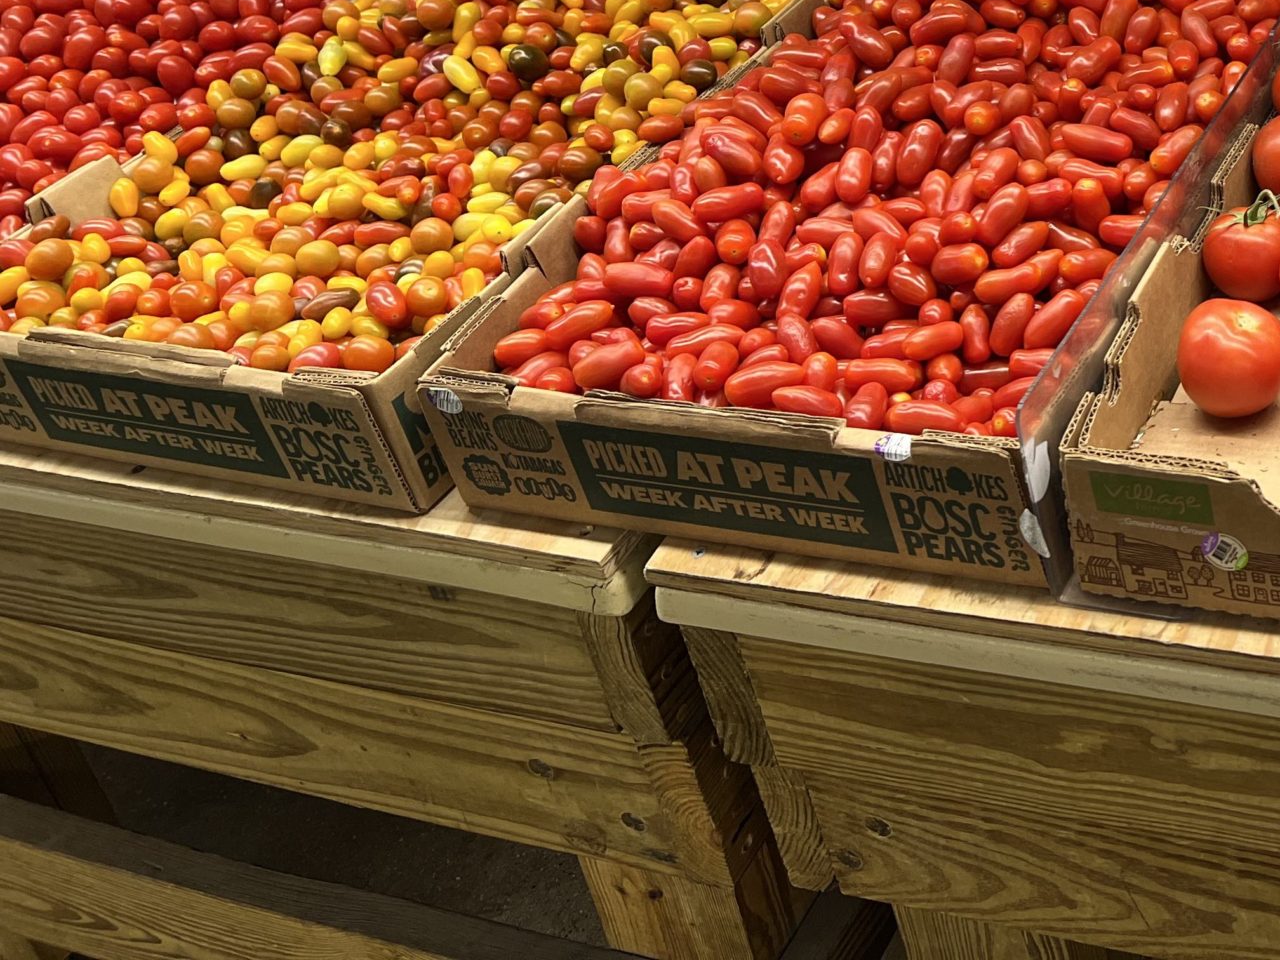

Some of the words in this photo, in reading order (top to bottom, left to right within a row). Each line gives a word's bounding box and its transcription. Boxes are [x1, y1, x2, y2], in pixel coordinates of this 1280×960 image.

[28, 376, 100, 412] PICKED
[99, 388, 148, 419] AT
[150, 394, 251, 436] PEAK
[441, 412, 490, 432] STRING
[48, 413, 117, 440] WEEK
[123, 425, 199, 453] AFTER
[200, 437, 265, 464] WEEK
[271, 423, 362, 469] BOSC
[450, 427, 498, 452] BEANS
[288, 457, 375, 494] PEARS
[470, 462, 500, 473] SUN
[582, 439, 669, 478] PICKED
[676, 450, 726, 486] AT
[731, 457, 860, 504] PEAK
[600, 481, 691, 509] WEEK
[692, 491, 785, 522] AFTER
[789, 507, 870, 535] WEEK
[890, 492, 996, 540] BOSC
[1103, 483, 1201, 513] Village
[900, 531, 1006, 569] PEARS
